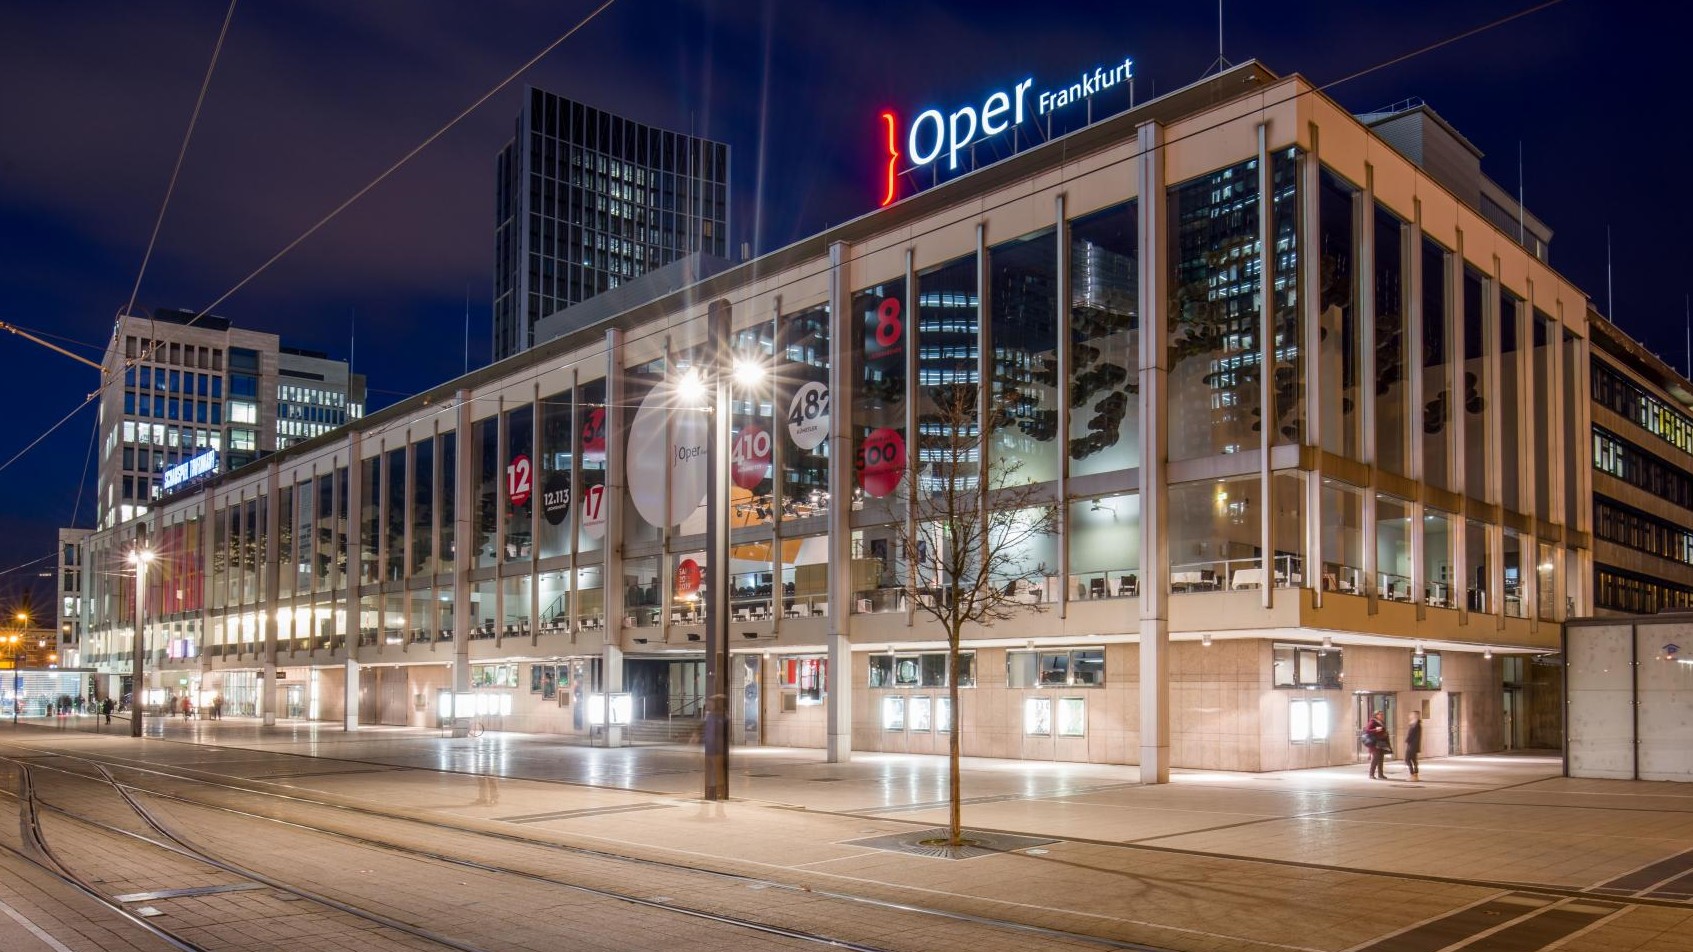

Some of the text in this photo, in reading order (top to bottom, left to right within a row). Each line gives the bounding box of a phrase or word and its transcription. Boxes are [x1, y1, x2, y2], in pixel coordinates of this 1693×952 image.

[909, 58, 1132, 170] Oper Frankfurt
[876, 297, 902, 347] 8
[788, 389, 829, 426] 482
[679, 446, 701, 462] Oper
[731, 431, 770, 465] 410
[856, 442, 896, 470] 500
[507, 459, 529, 494] 12
[544, 489, 569, 506] 12.113
[585, 486, 604, 520] 17
